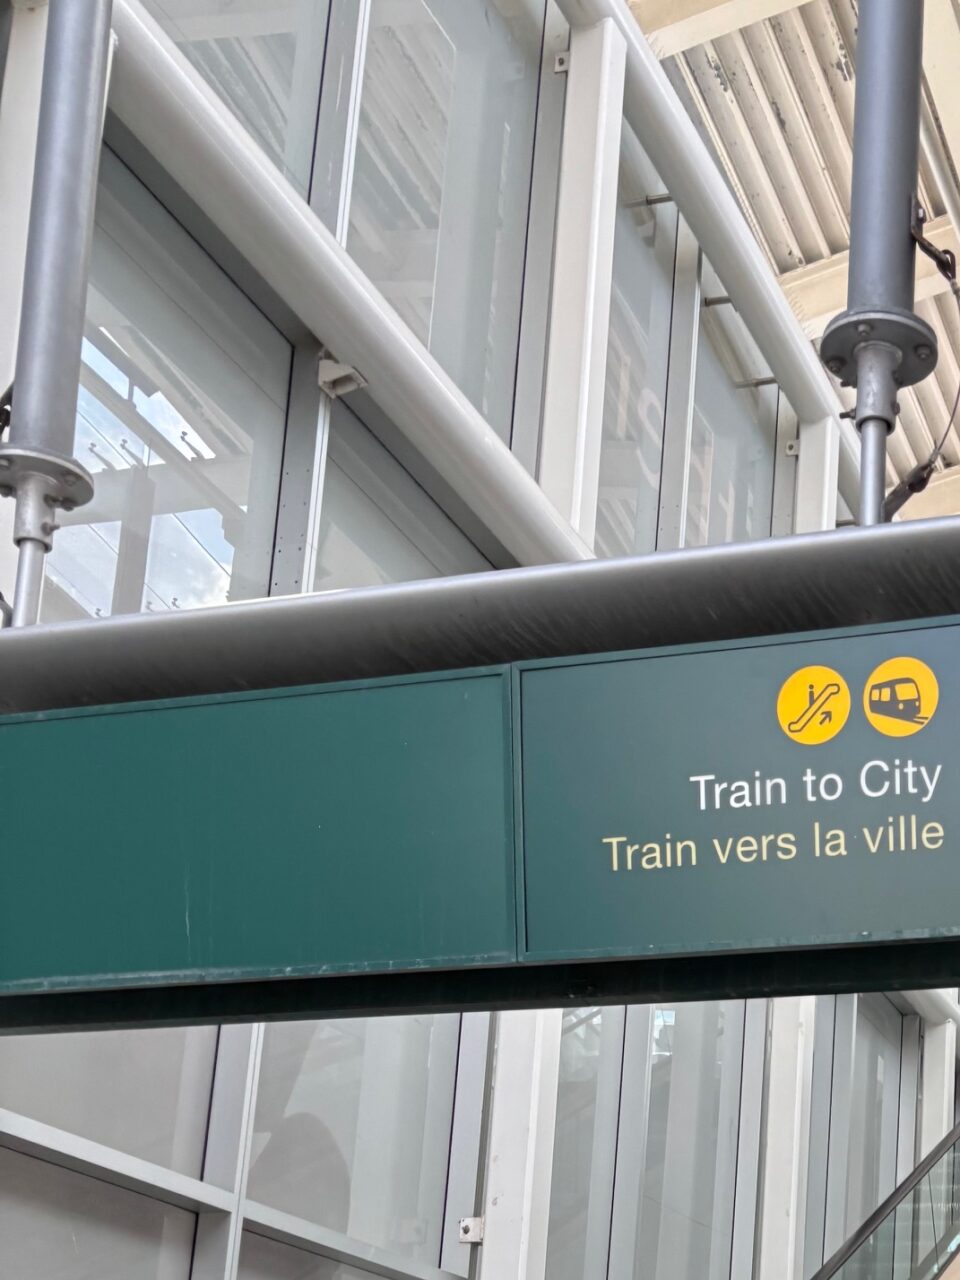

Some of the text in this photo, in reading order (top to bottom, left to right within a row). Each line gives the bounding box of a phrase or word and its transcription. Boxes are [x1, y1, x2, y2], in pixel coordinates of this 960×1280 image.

[690, 759, 943, 811] Train to City
[602, 814, 945, 872] Train vers la ville
